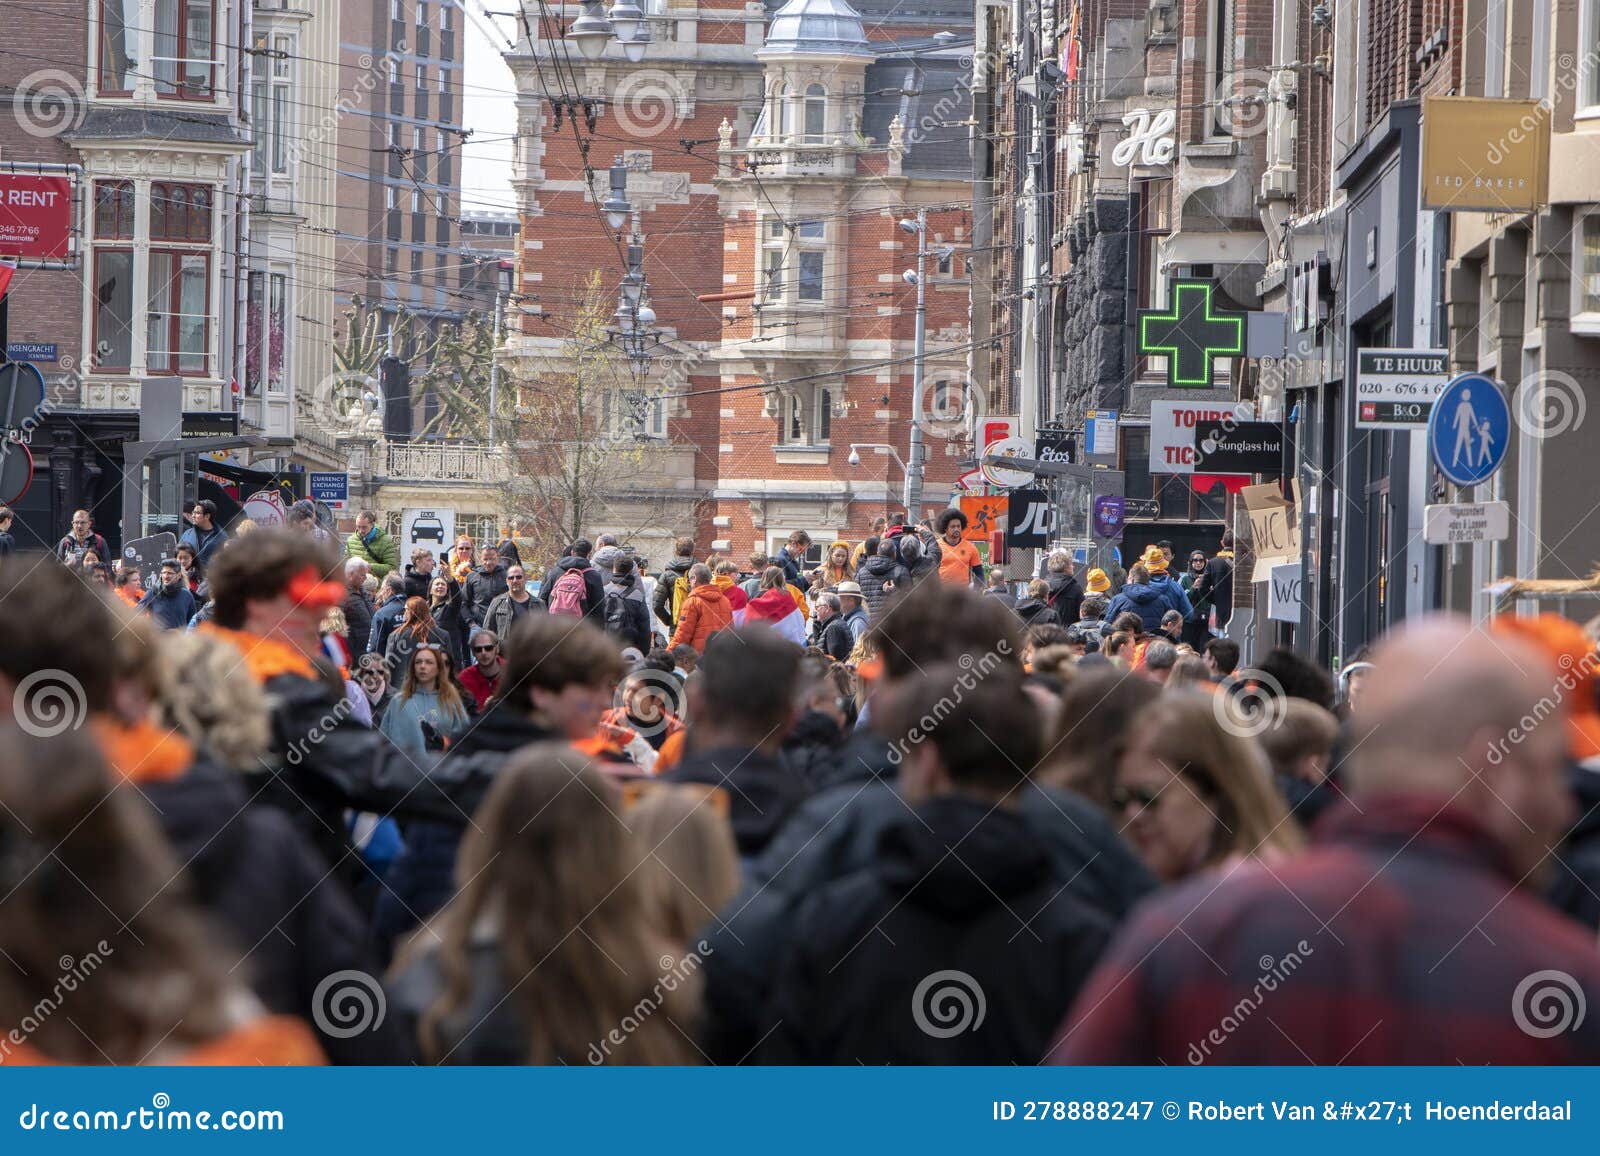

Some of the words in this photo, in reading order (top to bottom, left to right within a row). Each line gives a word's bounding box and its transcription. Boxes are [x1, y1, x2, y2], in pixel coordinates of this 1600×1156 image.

[1434, 176, 1463, 187] TED
[1475, 177, 1527, 189] BAKER
[8, 190, 58, 208] RENT
[1373, 358, 1394, 371] TE
[1397, 359, 1443, 372] HUUR
[1360, 383, 1383, 393] 020
[1395, 383, 1417, 394] 676
[1393, 404, 1421, 417] B&O
[1218, 441, 1262, 453] sunglass
[1263, 441, 1280, 452] hut
[1013, 502, 1057, 535] JD
[1251, 512, 1283, 551] WC
